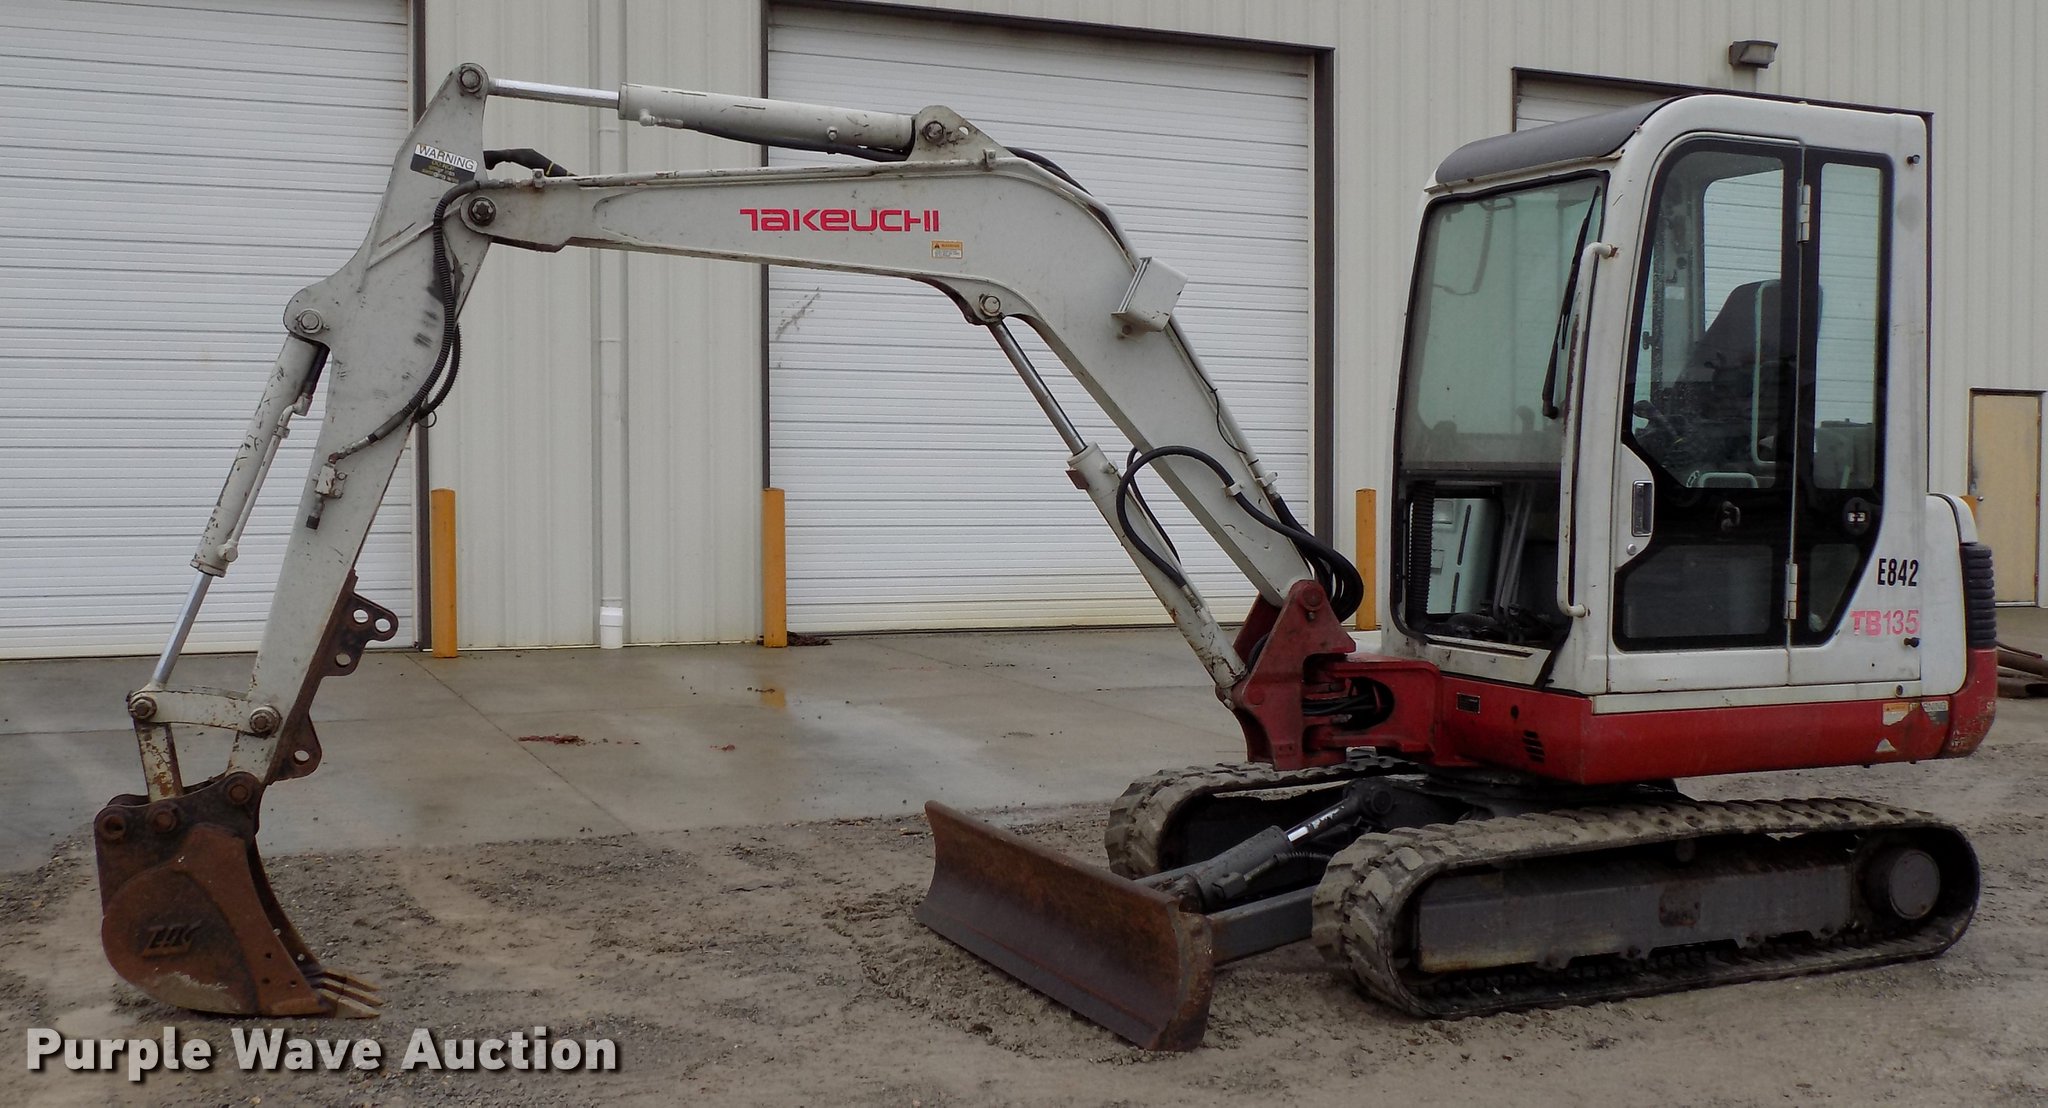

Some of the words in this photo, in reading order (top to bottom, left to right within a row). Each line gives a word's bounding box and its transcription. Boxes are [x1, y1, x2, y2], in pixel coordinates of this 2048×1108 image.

[419, 145, 475, 170] WARNING
[1877, 558, 1919, 587] E842
[1850, 609, 1920, 636] TB135
